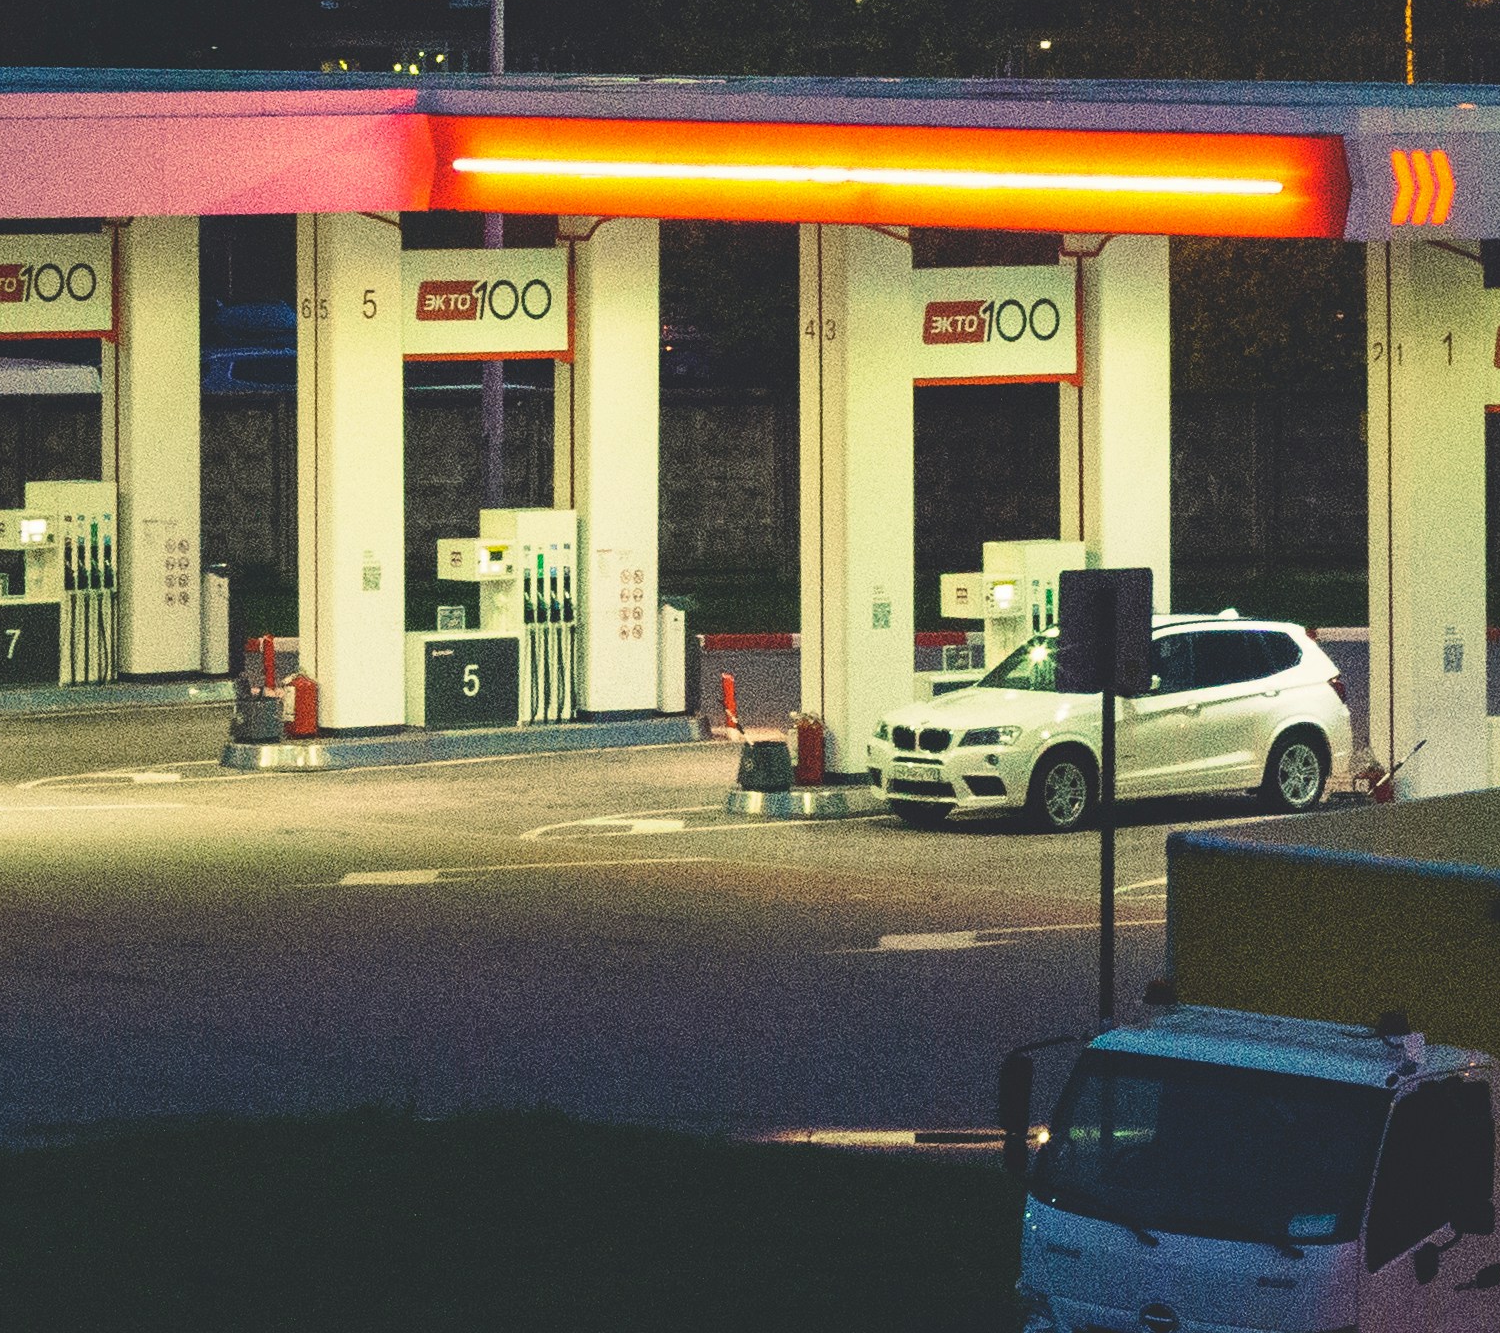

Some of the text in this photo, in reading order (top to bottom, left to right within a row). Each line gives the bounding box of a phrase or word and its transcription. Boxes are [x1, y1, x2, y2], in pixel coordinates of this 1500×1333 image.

[20, 263, 97, 303] 100
[301, 298, 313, 320] 6
[318, 298, 329, 321] 5
[361, 289, 378, 320] 5
[423, 279, 553, 321] ЭКТО 100
[804, 320, 816, 340] 4
[824, 318, 837, 342] 3
[929, 298, 1061, 343] ЭКТО 100
[1396, 342, 1403, 366] 1
[1442, 331, 1453, 366] 1
[5, 628, 22, 660] 7
[462, 663, 481, 698] 5
